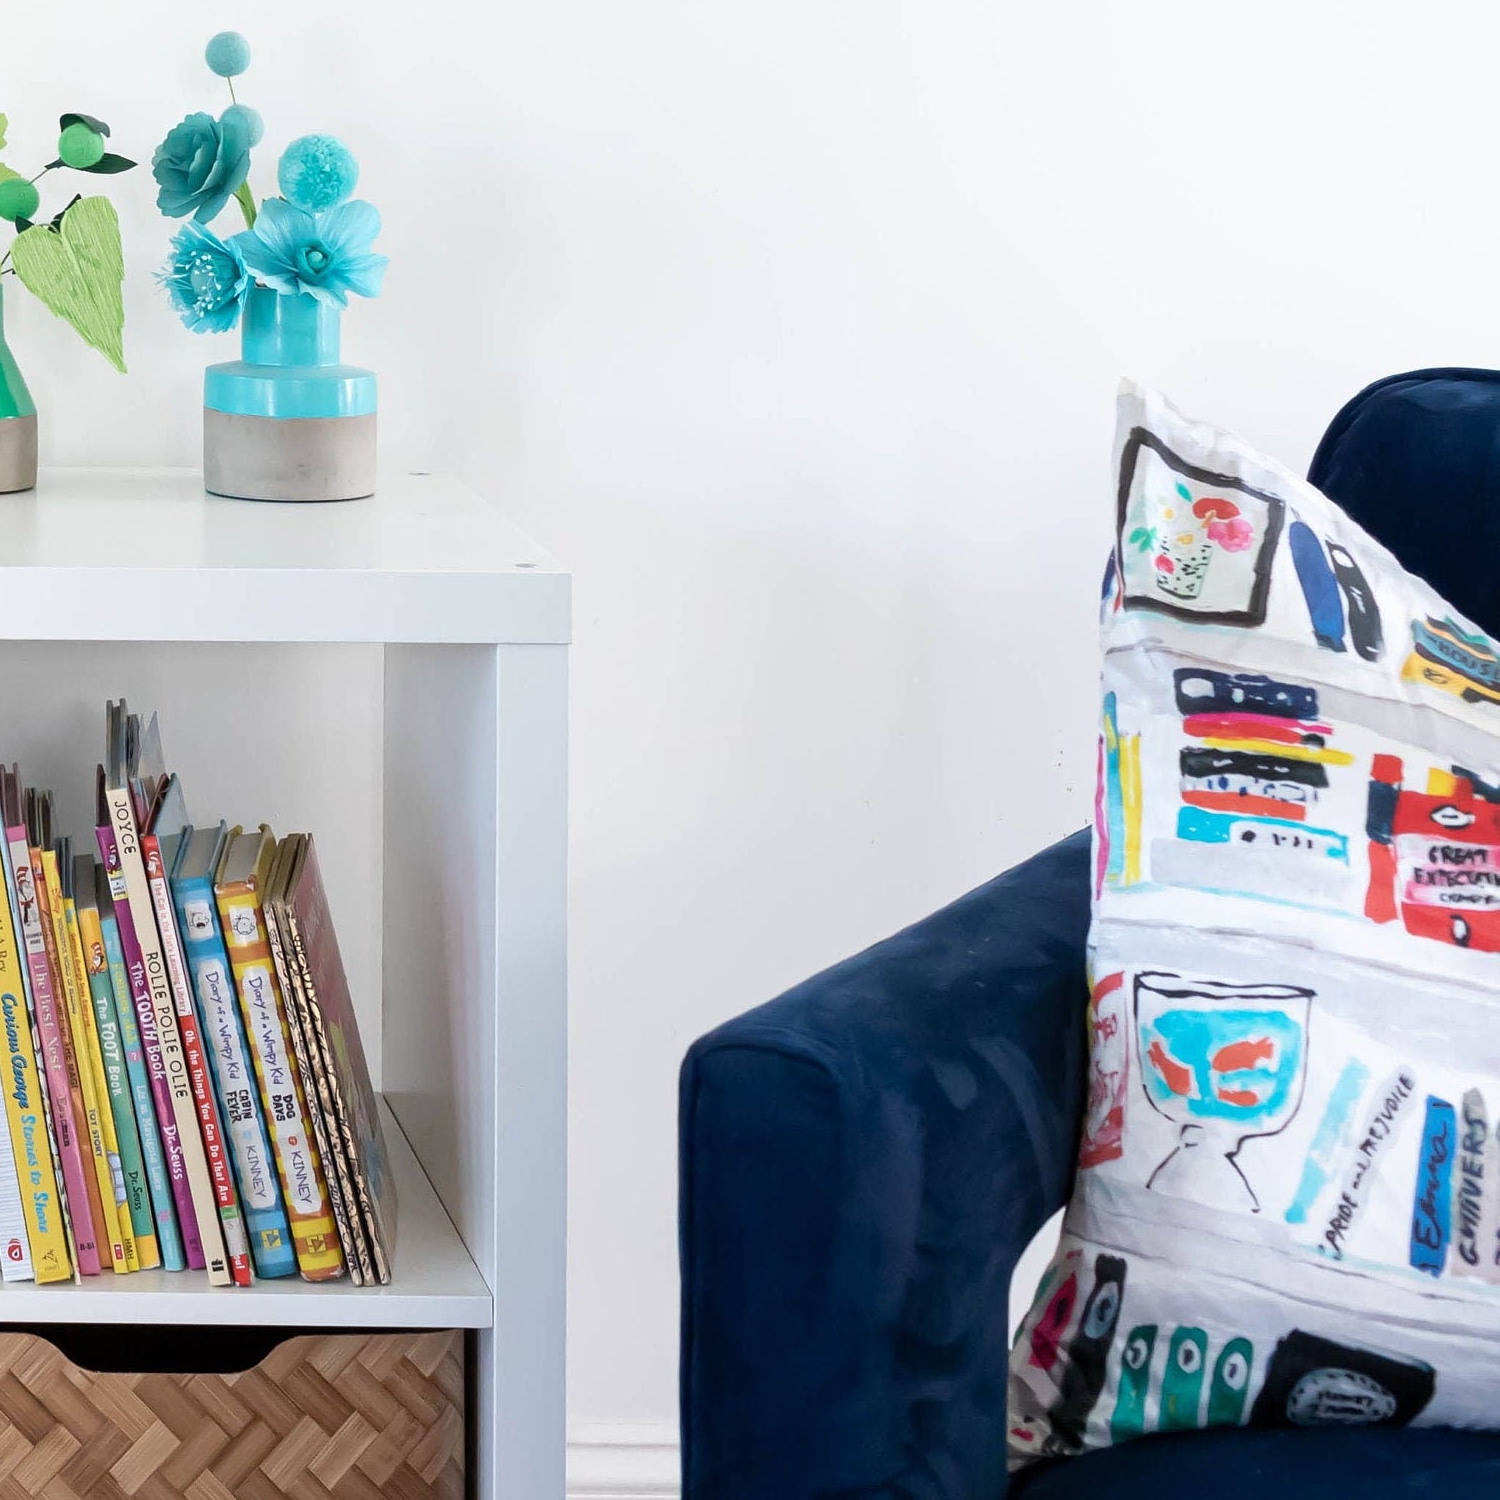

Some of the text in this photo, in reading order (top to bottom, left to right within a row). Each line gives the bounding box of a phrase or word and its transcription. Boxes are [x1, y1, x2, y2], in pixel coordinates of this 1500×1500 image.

[114, 801, 137, 854] JOYCE
[34, 963, 47, 990] The
[206, 971, 222, 1004] Diary
[249, 976, 267, 1009] Diary
[39, 995, 55, 1028] Best
[130, 964, 165, 1080] The TOOTH Book
[146, 951, 188, 1099] ROLIE POLIE OLIE
[217, 1006, 225, 1015] of
[261, 1012, 269, 1021] of
[96, 998, 108, 1020] The
[102, 1023, 119, 1061] FOOT
[218, 1024, 232, 1060] Wimpy
[47, 1036, 61, 1071] Nest
[262, 1030, 276, 1066] Wimpy
[228, 1062, 240, 1079] Kid
[271, 1067, 284, 1085] Kid
[1, 993, 49, 1234] Curious George Stories to Share
[185, 1030, 228, 1202] Oh, the Things You Can Do That Are
[226, 1091, 241, 1123] FEVER
[239, 1089, 252, 1120] CABIN
[272, 1095, 285, 1122] DAYS
[283, 1094, 295, 1119] DOG
[163, 1124, 183, 1180] Dr. Seuss
[246, 1145, 267, 1198] KINNEY
[292, 1151, 313, 1204] KINNEY
[128, 1171, 142, 1210] Dr. Seuss
